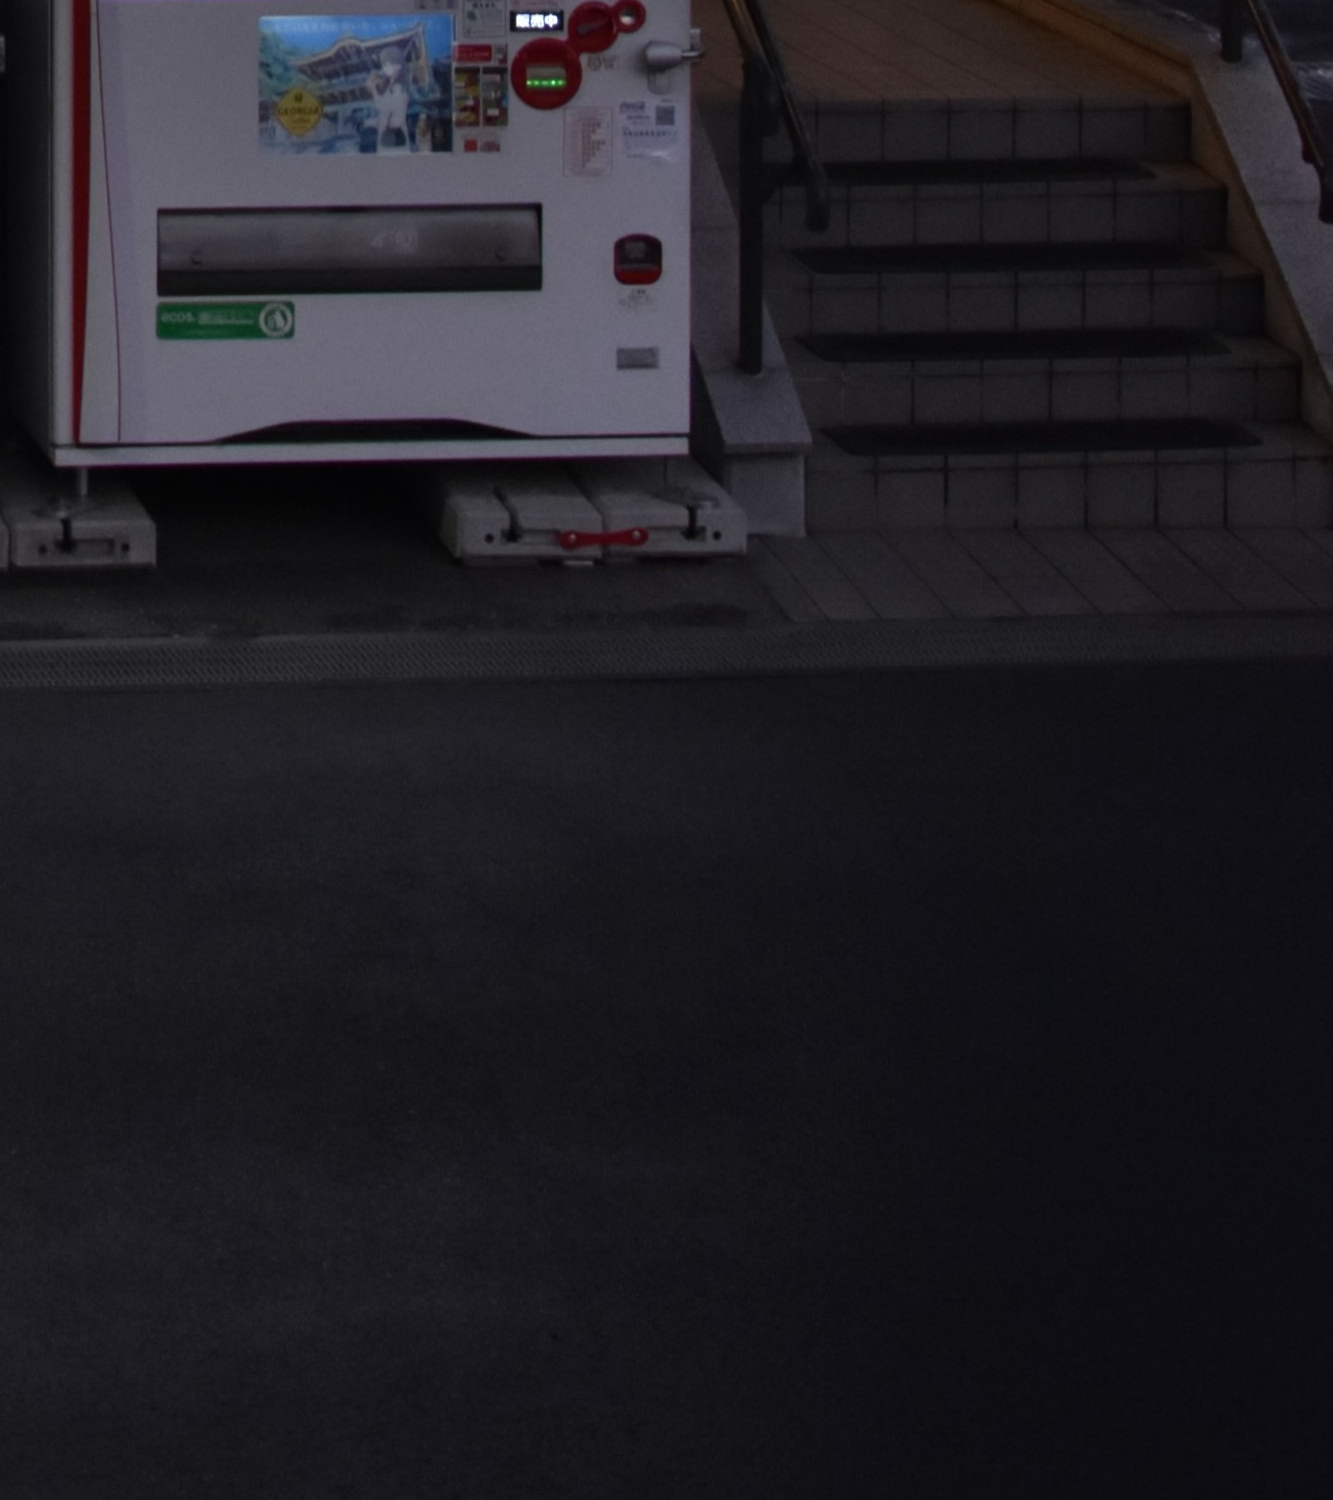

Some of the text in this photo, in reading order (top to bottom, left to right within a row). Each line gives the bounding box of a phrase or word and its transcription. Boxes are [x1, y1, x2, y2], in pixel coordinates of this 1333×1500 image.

[516, 13, 558, 28] 販売中
[277, 106, 319, 116] GEORGIA
